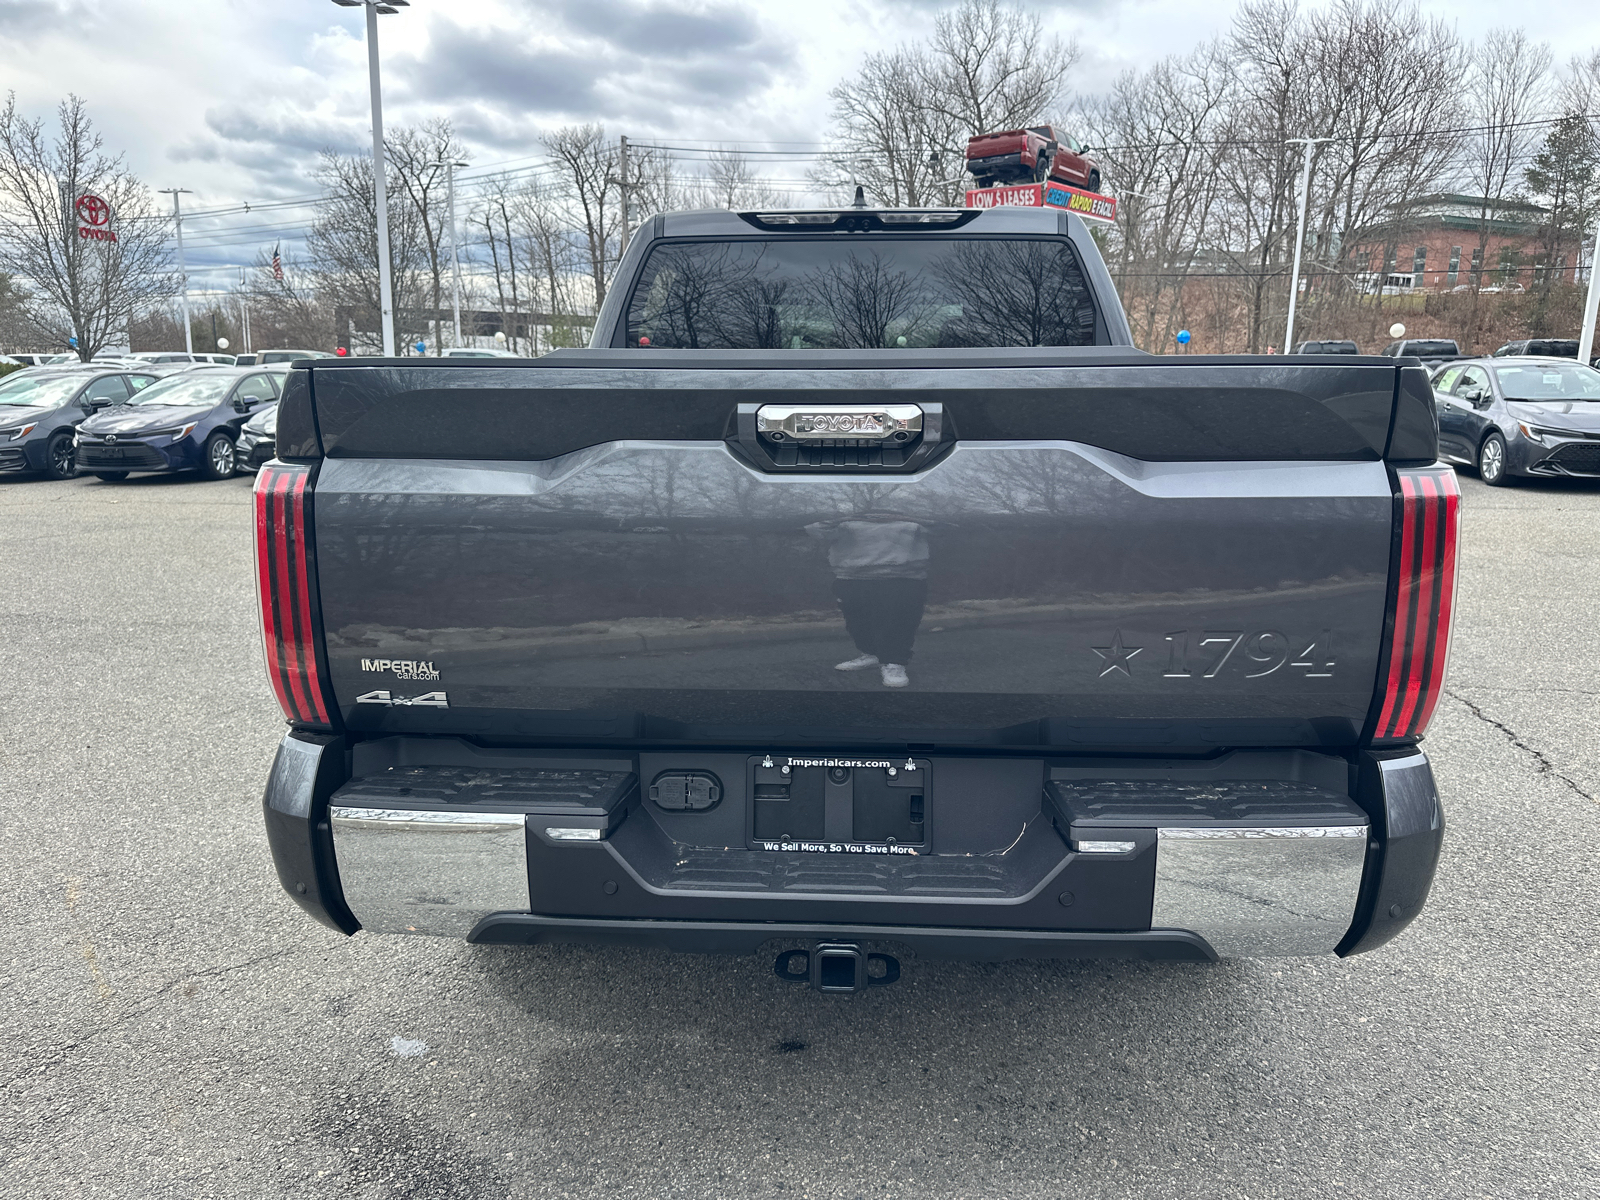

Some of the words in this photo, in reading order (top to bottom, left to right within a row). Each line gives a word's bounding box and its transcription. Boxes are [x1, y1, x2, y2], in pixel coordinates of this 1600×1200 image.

[972, 192, 994, 208] LOW
[1003, 189, 1035, 206] LEASES
[78, 227, 117, 243] OYOTA
[802, 415, 877, 432] TOYOTA
[1161, 628, 1336, 679] 1794
[361, 658, 440, 674] IMPERIAL
[397, 672, 440, 681] cars.com
[787, 757, 891, 769] Imperialcars.com
[764, 842, 779, 851] We
[781, 843, 799, 852] Sell
[801, 843, 828, 853] More,
[829, 844, 842, 853] So
[844, 844, 863, 854] You
[864, 845, 888, 853] Save
